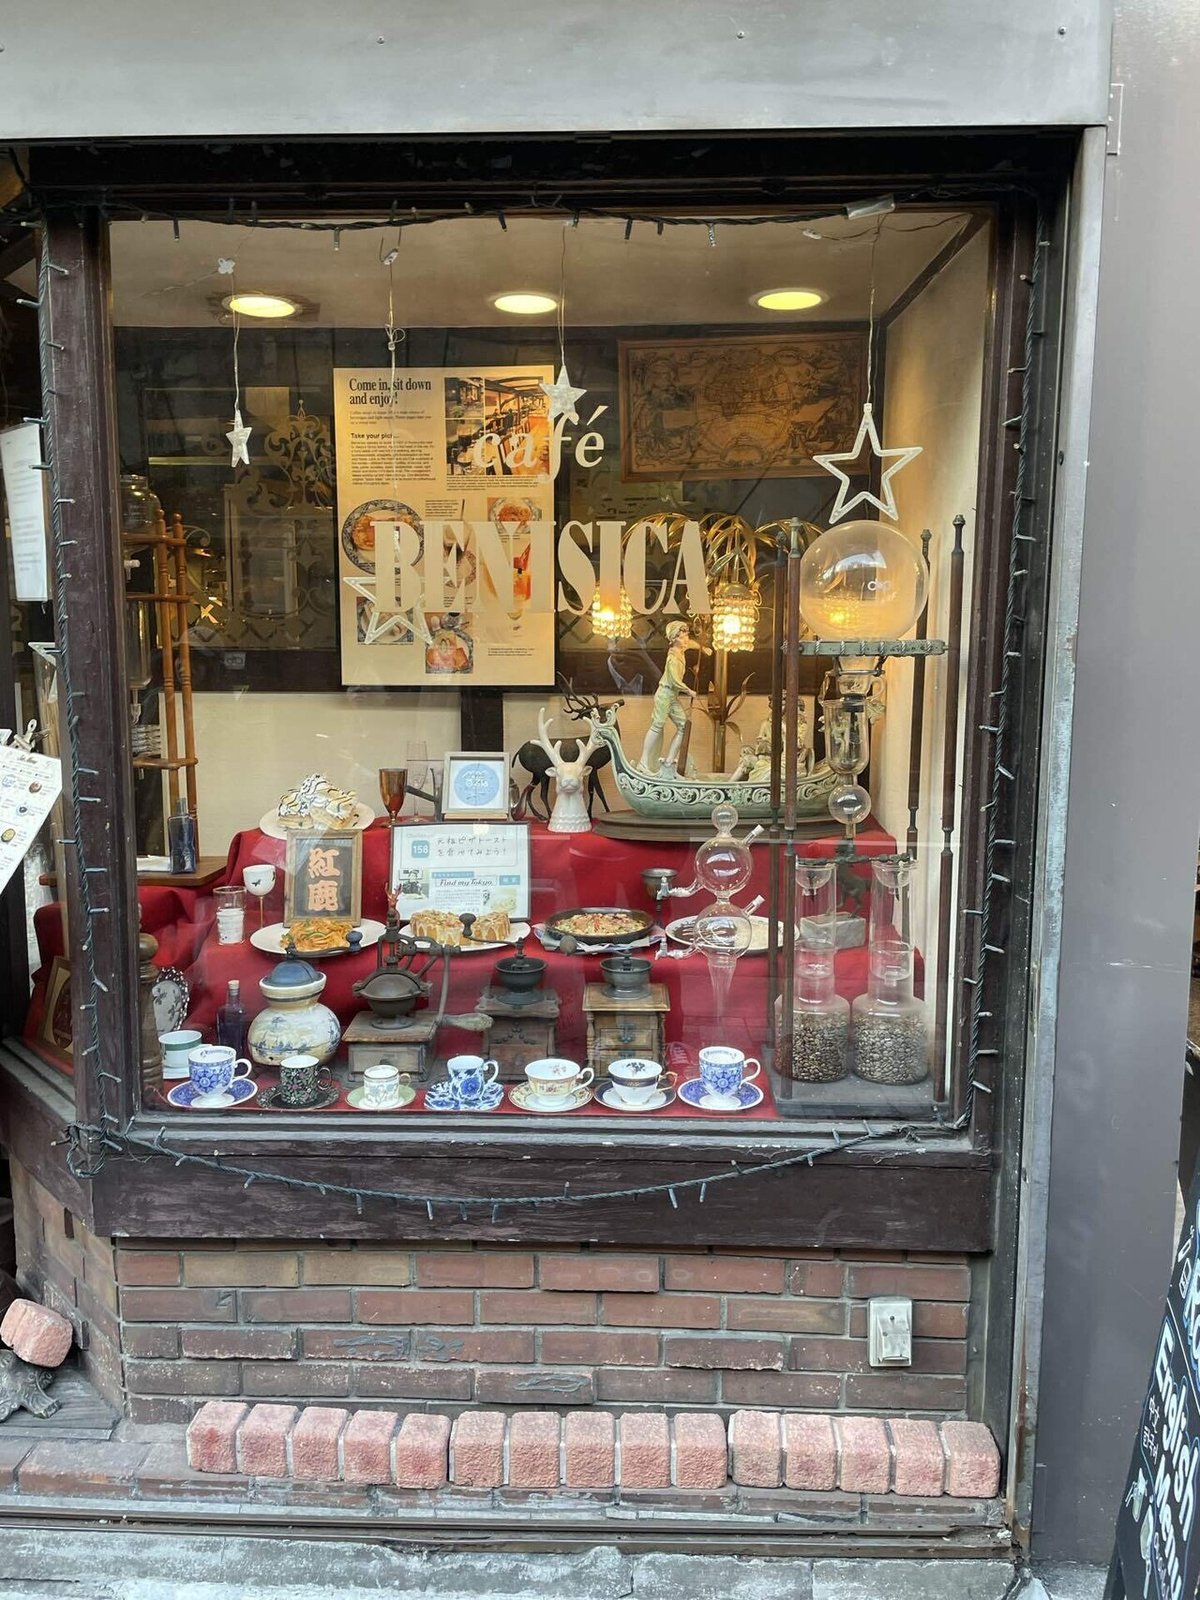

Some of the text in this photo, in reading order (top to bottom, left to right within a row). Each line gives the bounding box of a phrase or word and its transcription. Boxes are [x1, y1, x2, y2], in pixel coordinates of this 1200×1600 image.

[349, 378, 431, 392] Come in, sit down
[349, 392, 367, 405] and
[474, 405, 608, 484] café
[370, 520, 716, 616] BENISICA
[413, 845, 428, 854] 158
[1156, 1322, 1198, 1541] English
[1155, 1453, 1182, 1600] Menu
